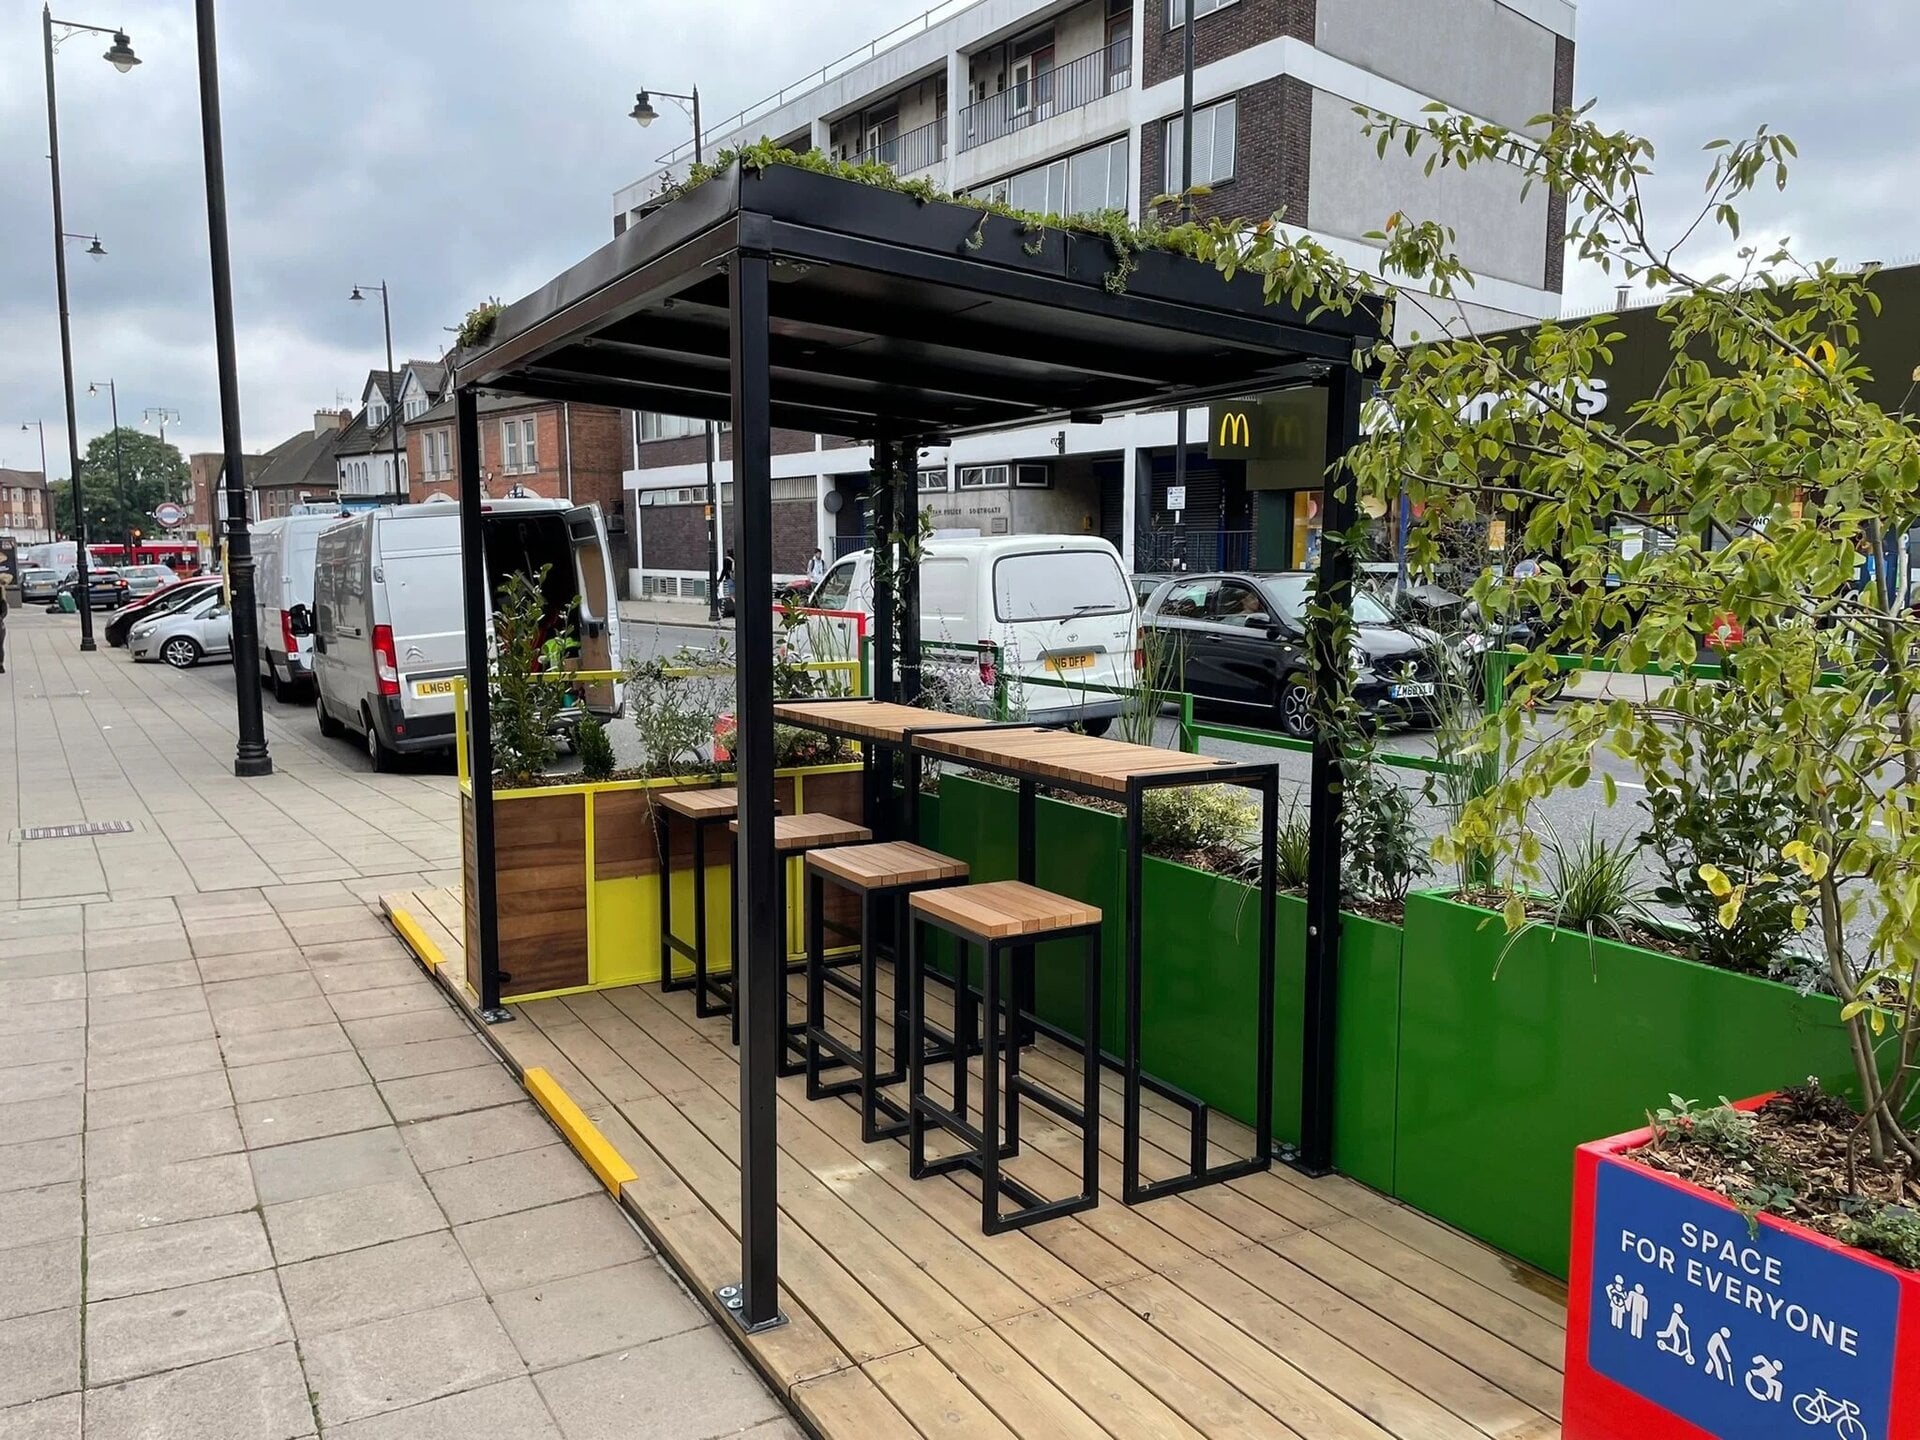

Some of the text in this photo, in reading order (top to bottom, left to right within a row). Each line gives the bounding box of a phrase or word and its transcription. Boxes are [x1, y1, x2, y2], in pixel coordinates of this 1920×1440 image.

[1621, 1229, 1859, 1357] FOR EVERYONE
[1680, 1221, 1783, 1286] SPACE
